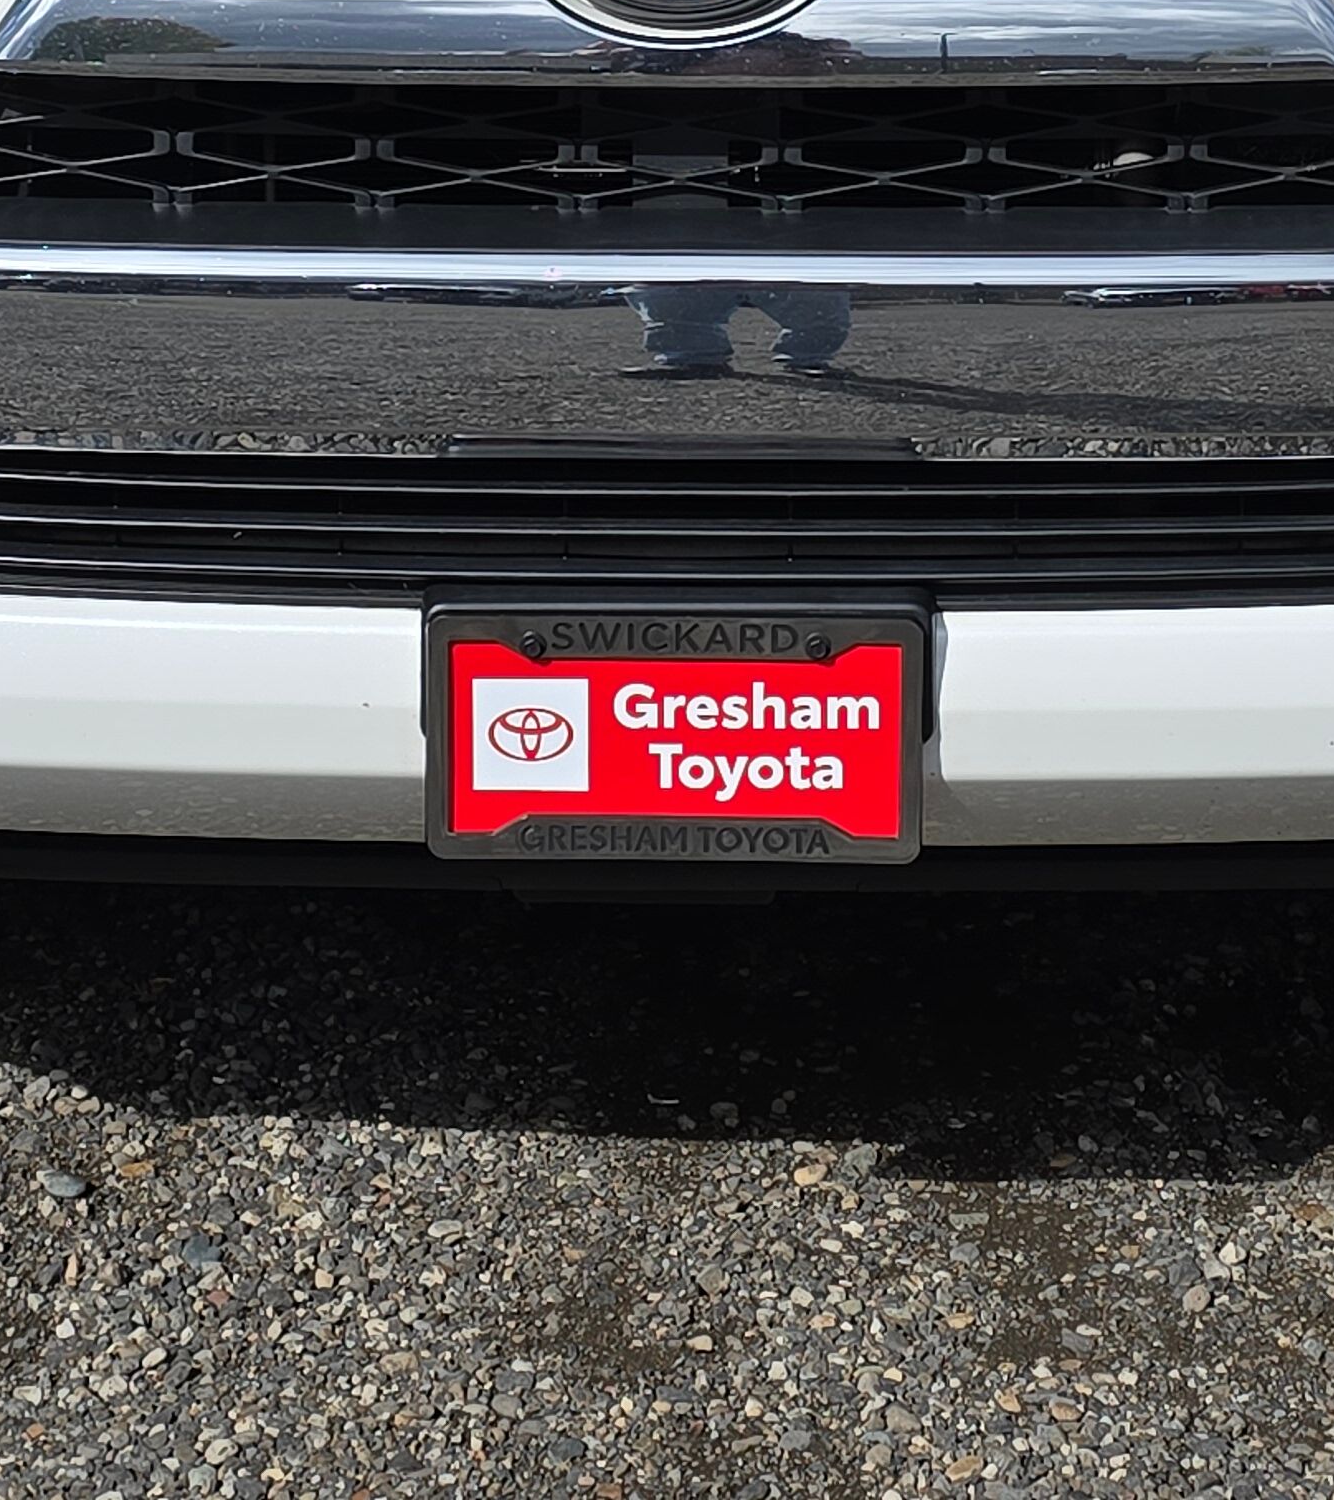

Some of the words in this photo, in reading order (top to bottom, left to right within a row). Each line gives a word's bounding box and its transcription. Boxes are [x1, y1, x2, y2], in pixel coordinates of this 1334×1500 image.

[551, 621, 799, 654] SWICKARD
[613, 681, 880, 730] Gresham
[648, 743, 844, 802] Toyota
[520, 824, 688, 853] GRESHAM
[697, 826, 831, 855] TOYOTA
